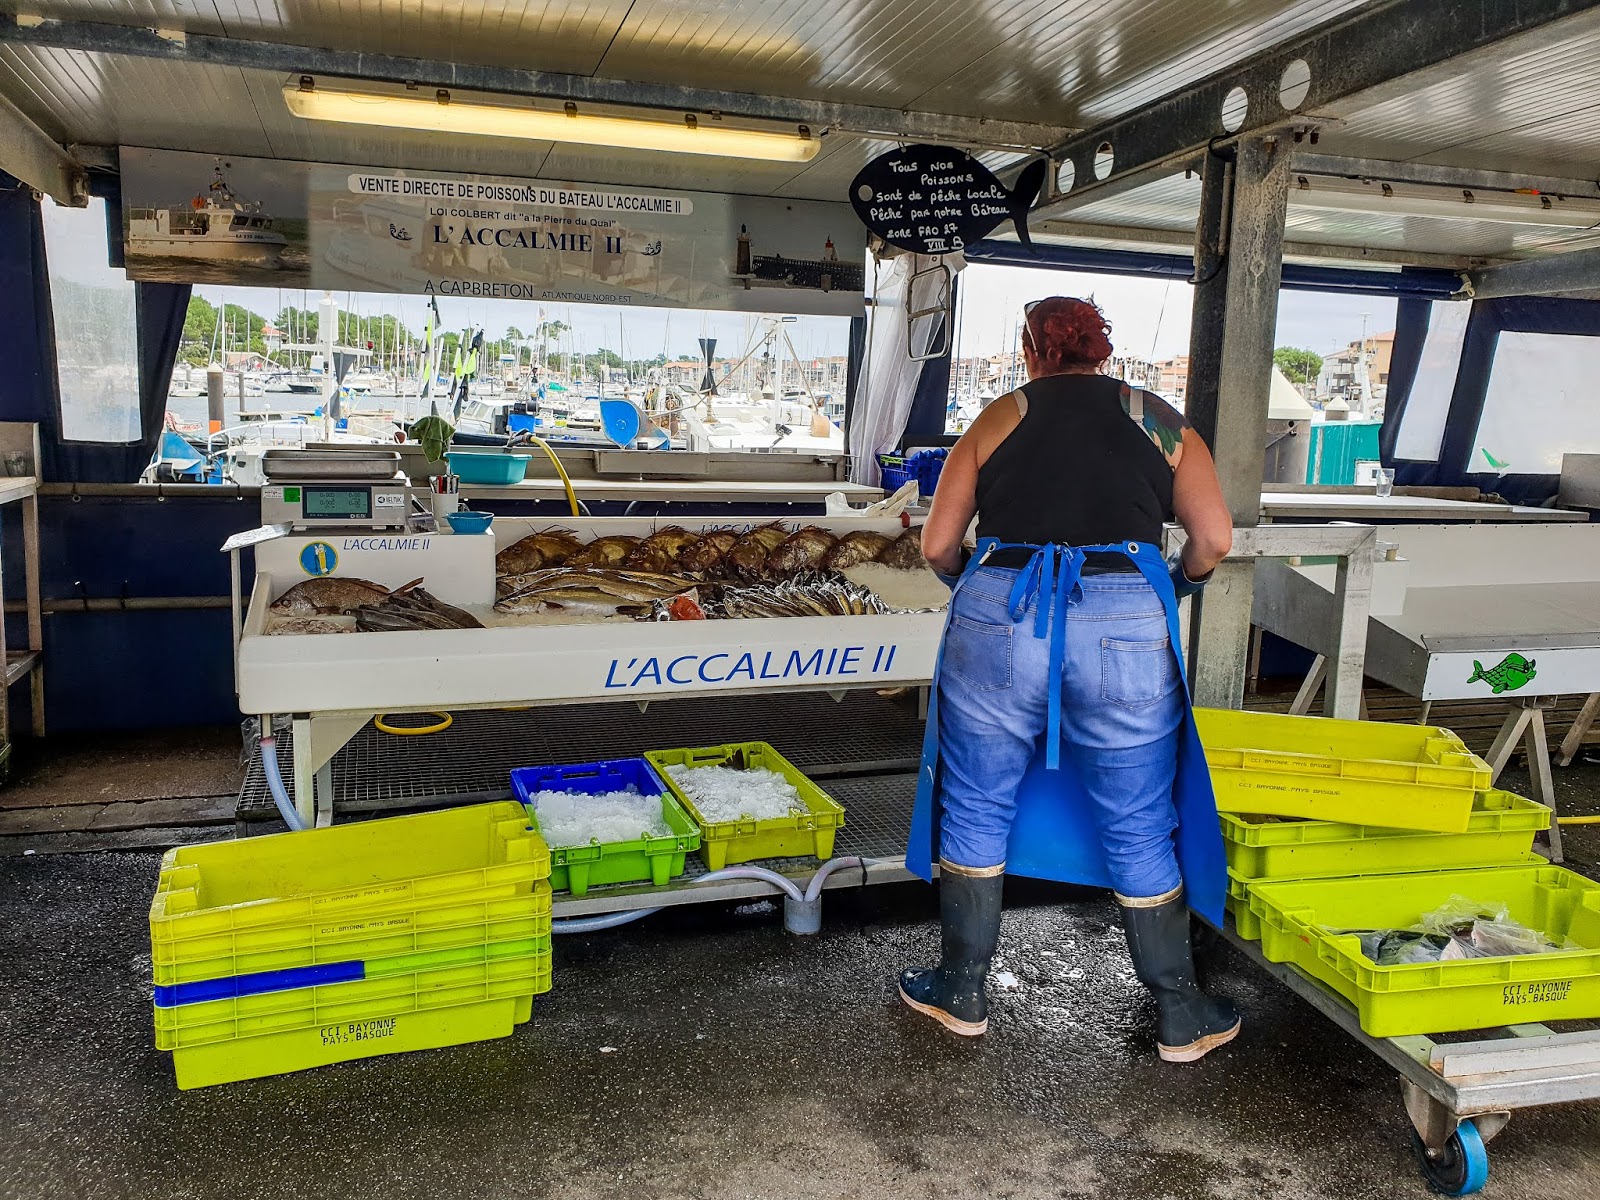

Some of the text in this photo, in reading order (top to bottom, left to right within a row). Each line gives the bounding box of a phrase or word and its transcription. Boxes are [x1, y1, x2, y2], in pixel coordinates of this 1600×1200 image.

[359, 177, 682, 214] VENTE DIRECTE DE POISSONS DU BATEAU L'ACCALMIE II
[908, 190, 922, 201] de
[430, 207, 448, 217] LOI
[450, 208, 501, 220] COLBERT
[503, 213, 517, 221] dit
[532, 215, 541, 223] la
[544, 215, 572, 225] Pierre
[574, 216, 587, 226] du
[590, 218, 617, 228] Quai"
[910, 210, 931, 221] par
[934, 206, 963, 218] notre
[918, 226, 939, 238] FAO
[944, 223, 959, 235] 27
[605, 236, 623, 255] II
[424, 279, 435, 294] A
[439, 280, 534, 298] CAPBRETON
[541, 290, 593, 301] ATLANTIQUE
[343, 538, 431, 551] L'ACCALMIE II
[604, 645, 898, 688] L'ACCALMIE II
